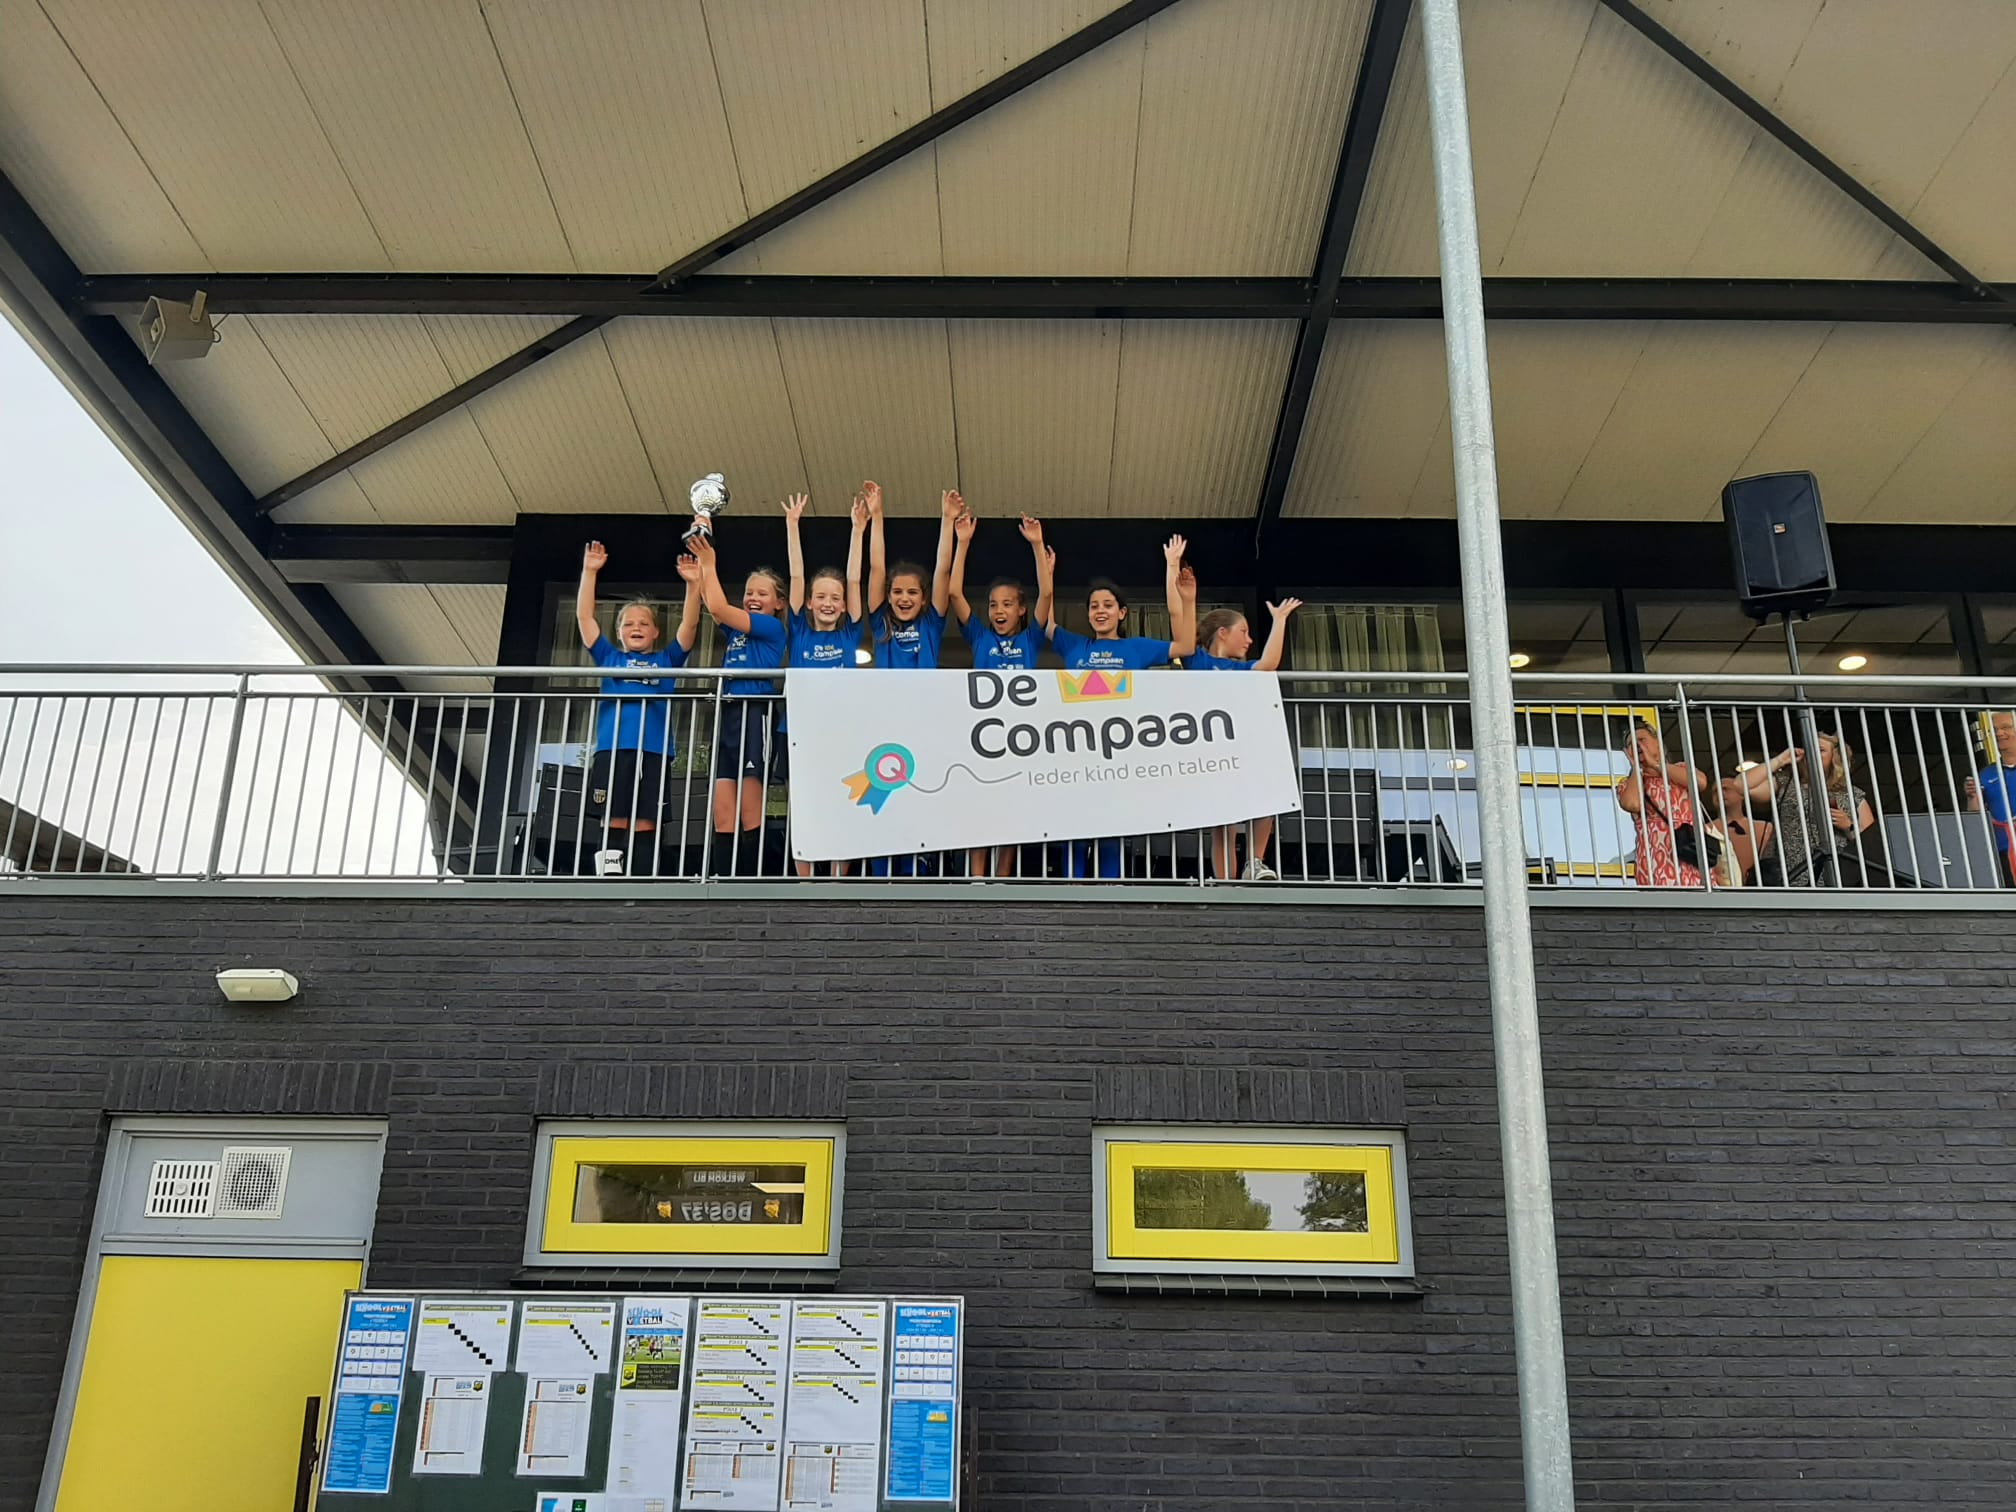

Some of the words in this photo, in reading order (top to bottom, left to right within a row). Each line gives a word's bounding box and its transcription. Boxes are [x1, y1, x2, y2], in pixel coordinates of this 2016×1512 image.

[967, 671, 1038, 710] De
[970, 709, 1235, 760] Compaan
[1028, 767, 1080, 786] Ieder
[1085, 763, 1129, 782] kind
[1135, 762, 1172, 779] een
[1178, 755, 1240, 774] talent
